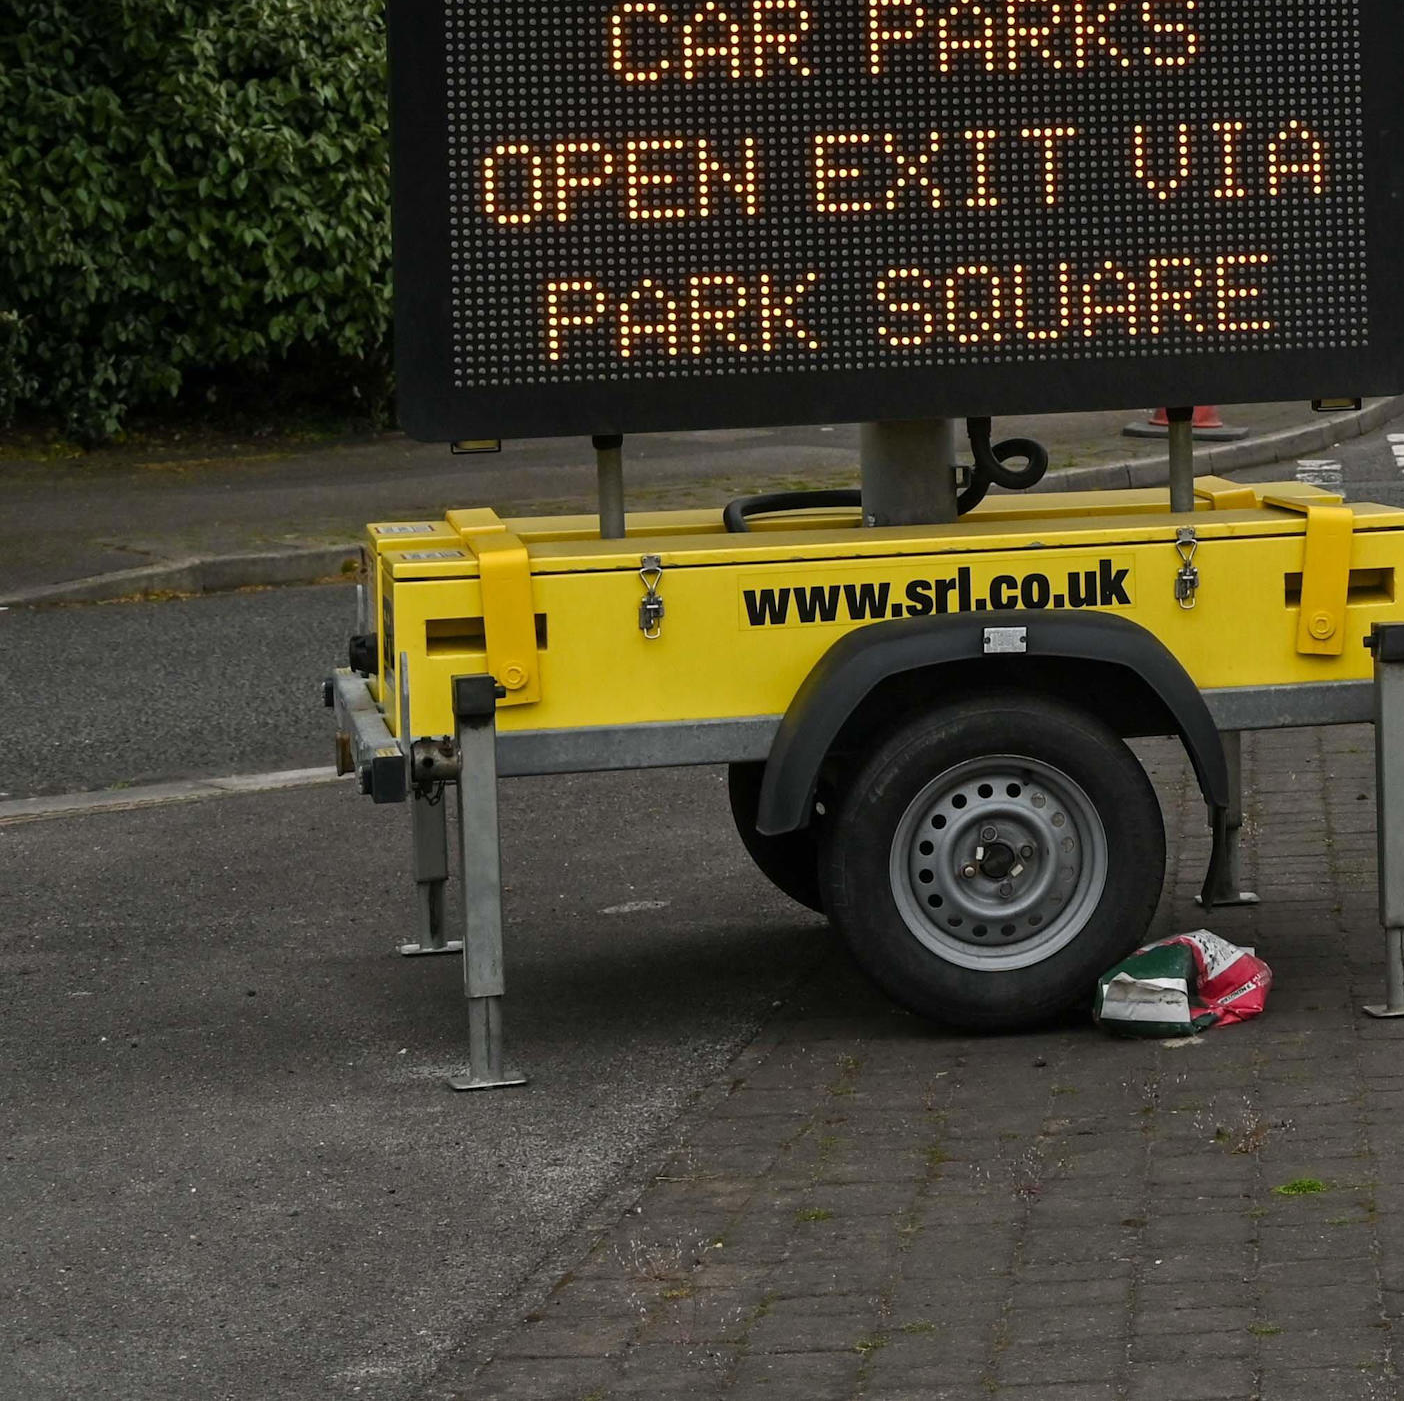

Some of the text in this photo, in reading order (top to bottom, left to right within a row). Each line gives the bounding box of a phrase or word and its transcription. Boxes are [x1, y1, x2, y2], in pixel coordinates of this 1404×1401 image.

[482, 119, 1323, 225] OPEN EXIT VIA
[546, 253, 1271, 362] PARK SQUARE
[742, 559, 1132, 626] www.srl.co.uk
